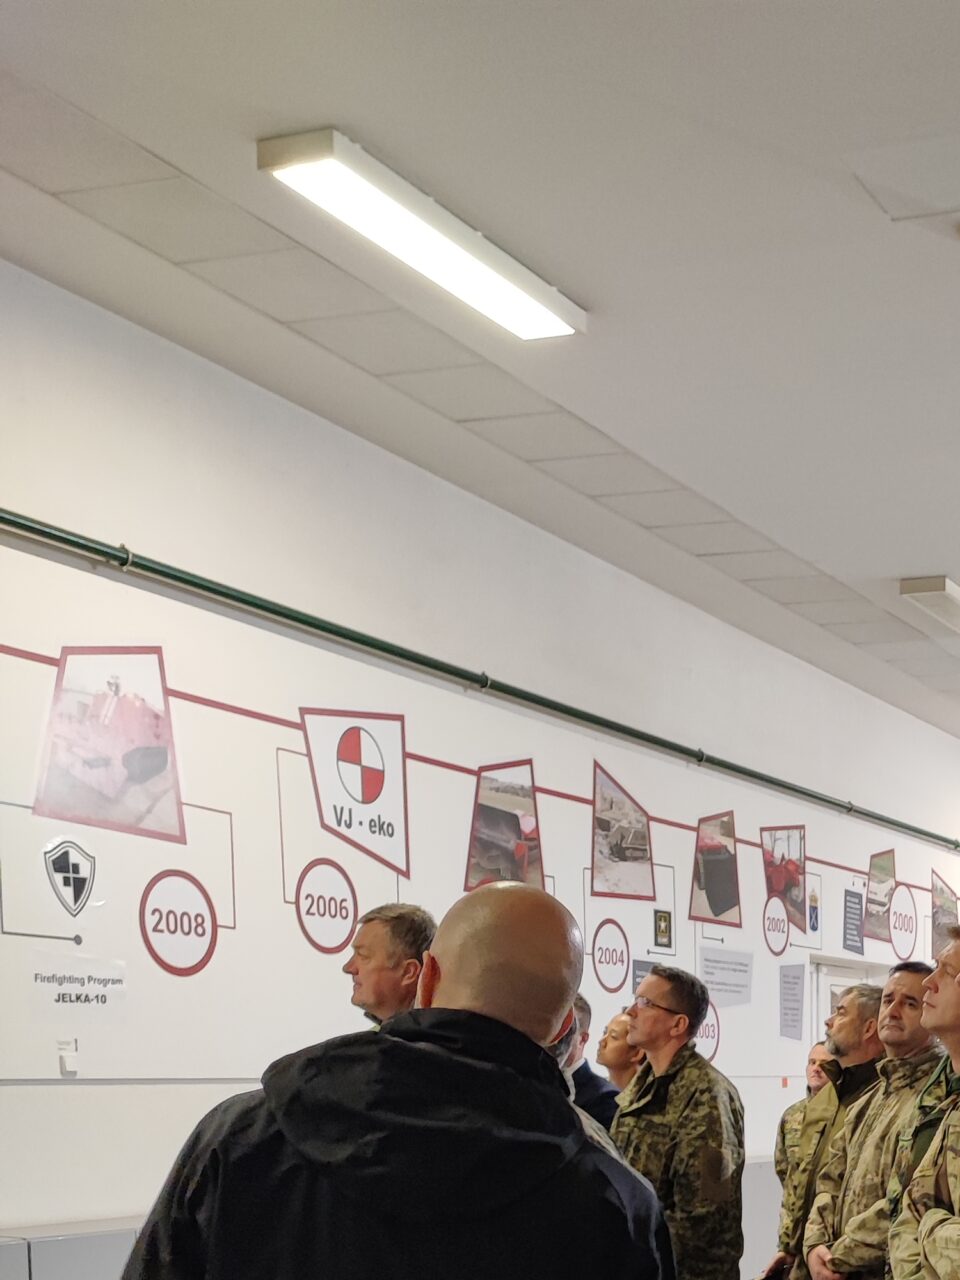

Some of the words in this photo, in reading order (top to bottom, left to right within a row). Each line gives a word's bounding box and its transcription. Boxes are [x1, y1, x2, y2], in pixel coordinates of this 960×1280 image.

[333, 804, 352, 830] VJ
[368, 814, 395, 838] eko
[304, 893, 349, 920] 2006
[151, 907, 206, 937] 2008
[766, 916, 786, 934] 2002
[893, 911, 914, 934] 2000
[597, 947, 625, 966] 2004
[34, 973, 85, 987] Firefighting
[87, 975, 123, 988] Program
[54, 992, 107, 1005] JELKA-10
[696, 1023, 716, 1040] 003
